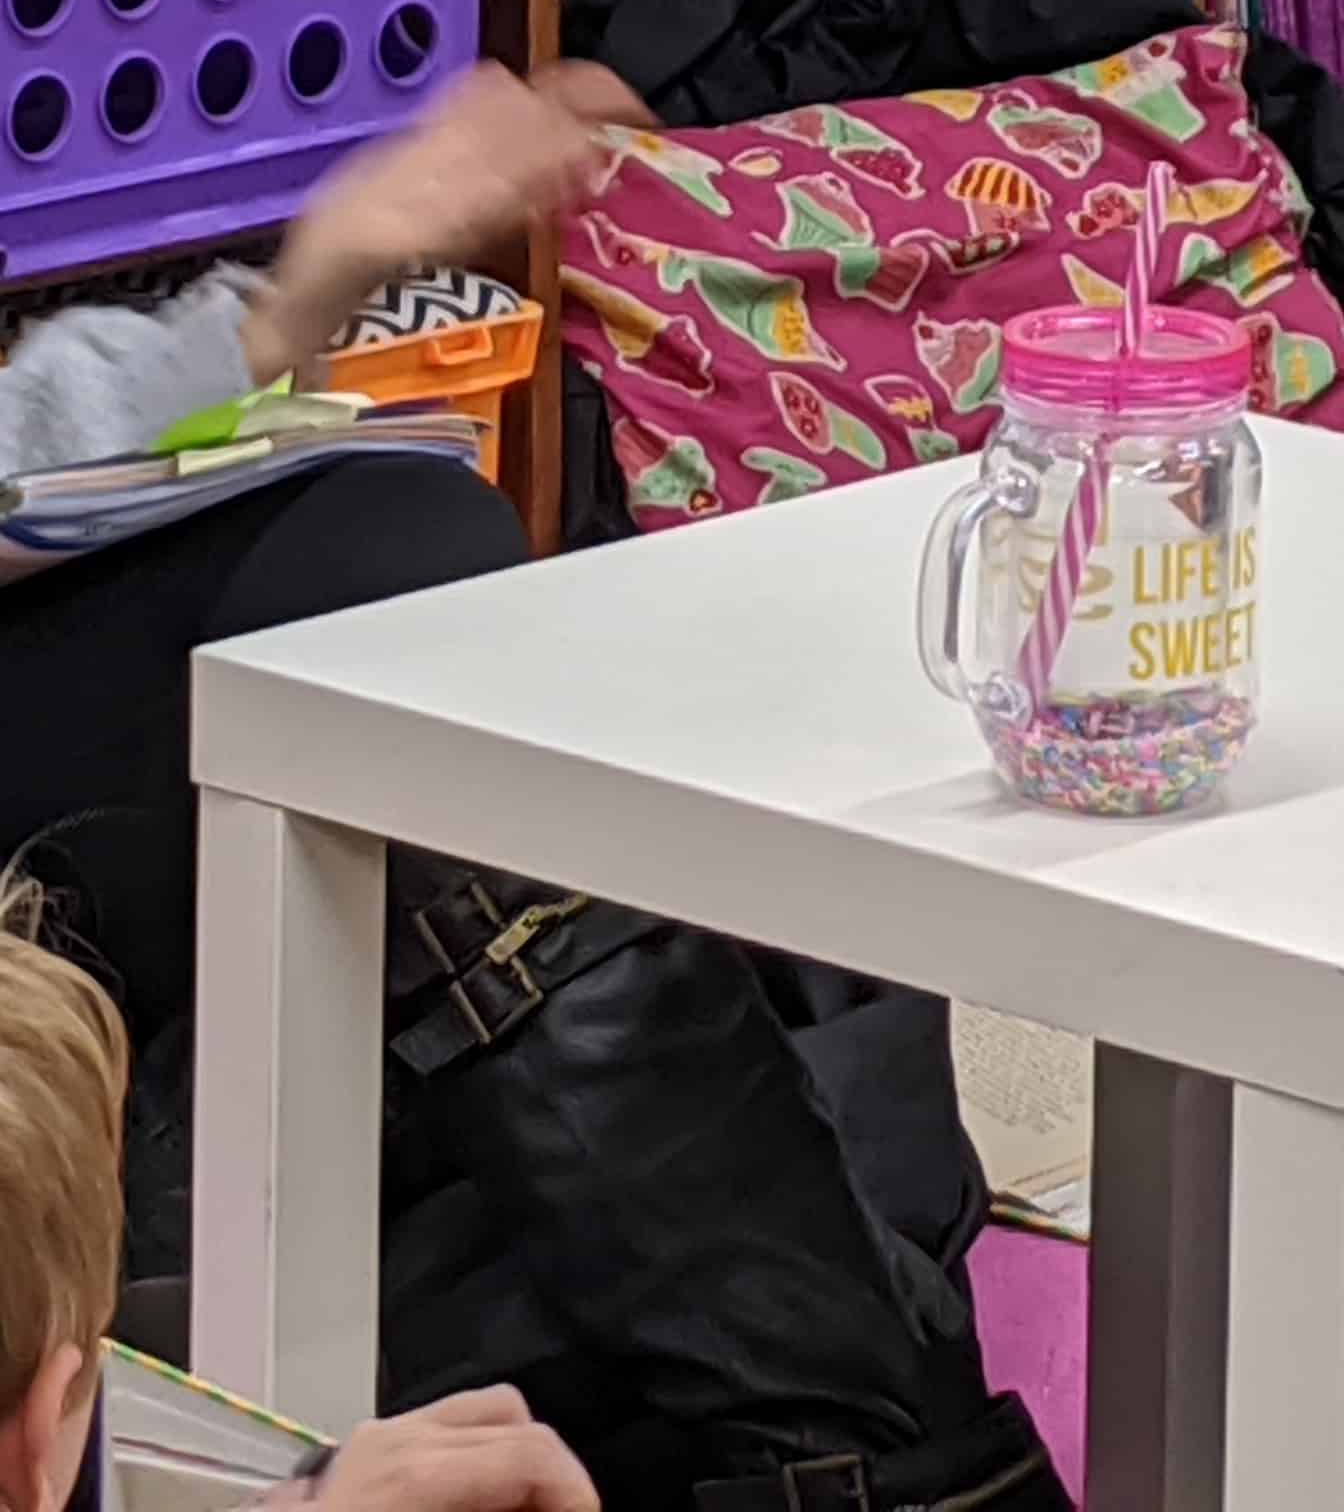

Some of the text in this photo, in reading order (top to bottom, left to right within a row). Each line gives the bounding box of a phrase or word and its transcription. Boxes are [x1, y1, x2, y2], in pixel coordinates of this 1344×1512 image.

[1134, 526, 1256, 604] LIFE IS
[1128, 600, 1256, 680] SWEET
